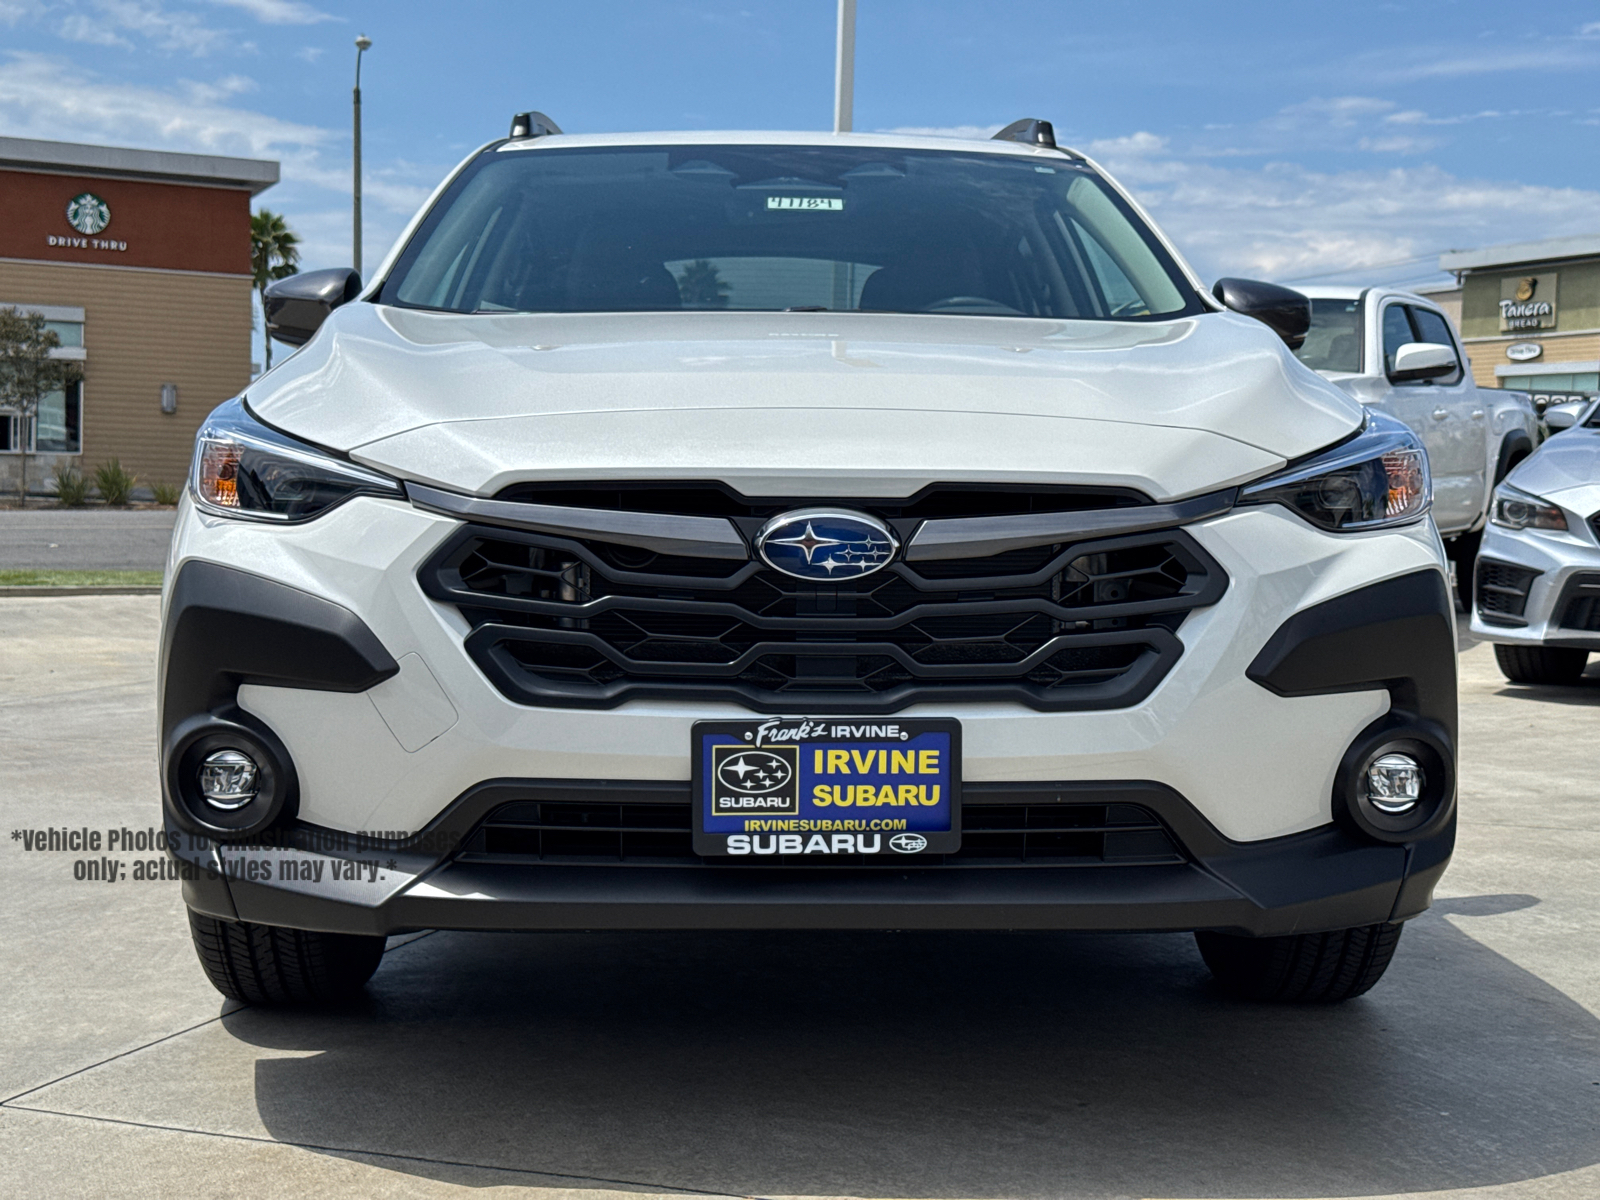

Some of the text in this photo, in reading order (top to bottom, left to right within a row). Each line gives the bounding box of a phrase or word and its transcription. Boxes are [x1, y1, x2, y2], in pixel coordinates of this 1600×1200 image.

[48, 235, 127, 251] DRIVE THRU
[1499, 300, 1550, 318] Panera
[1508, 319, 1538, 329] BREAD
[755, 717, 900, 748] Frank's IRVINE
[814, 749, 940, 774] IRVINE
[719, 797, 790, 808] SUBARU
[812, 784, 940, 807] SUBARU
[744, 818, 907, 831] IRVINESUBARU.COM
[727, 833, 881, 854] SUBARU
